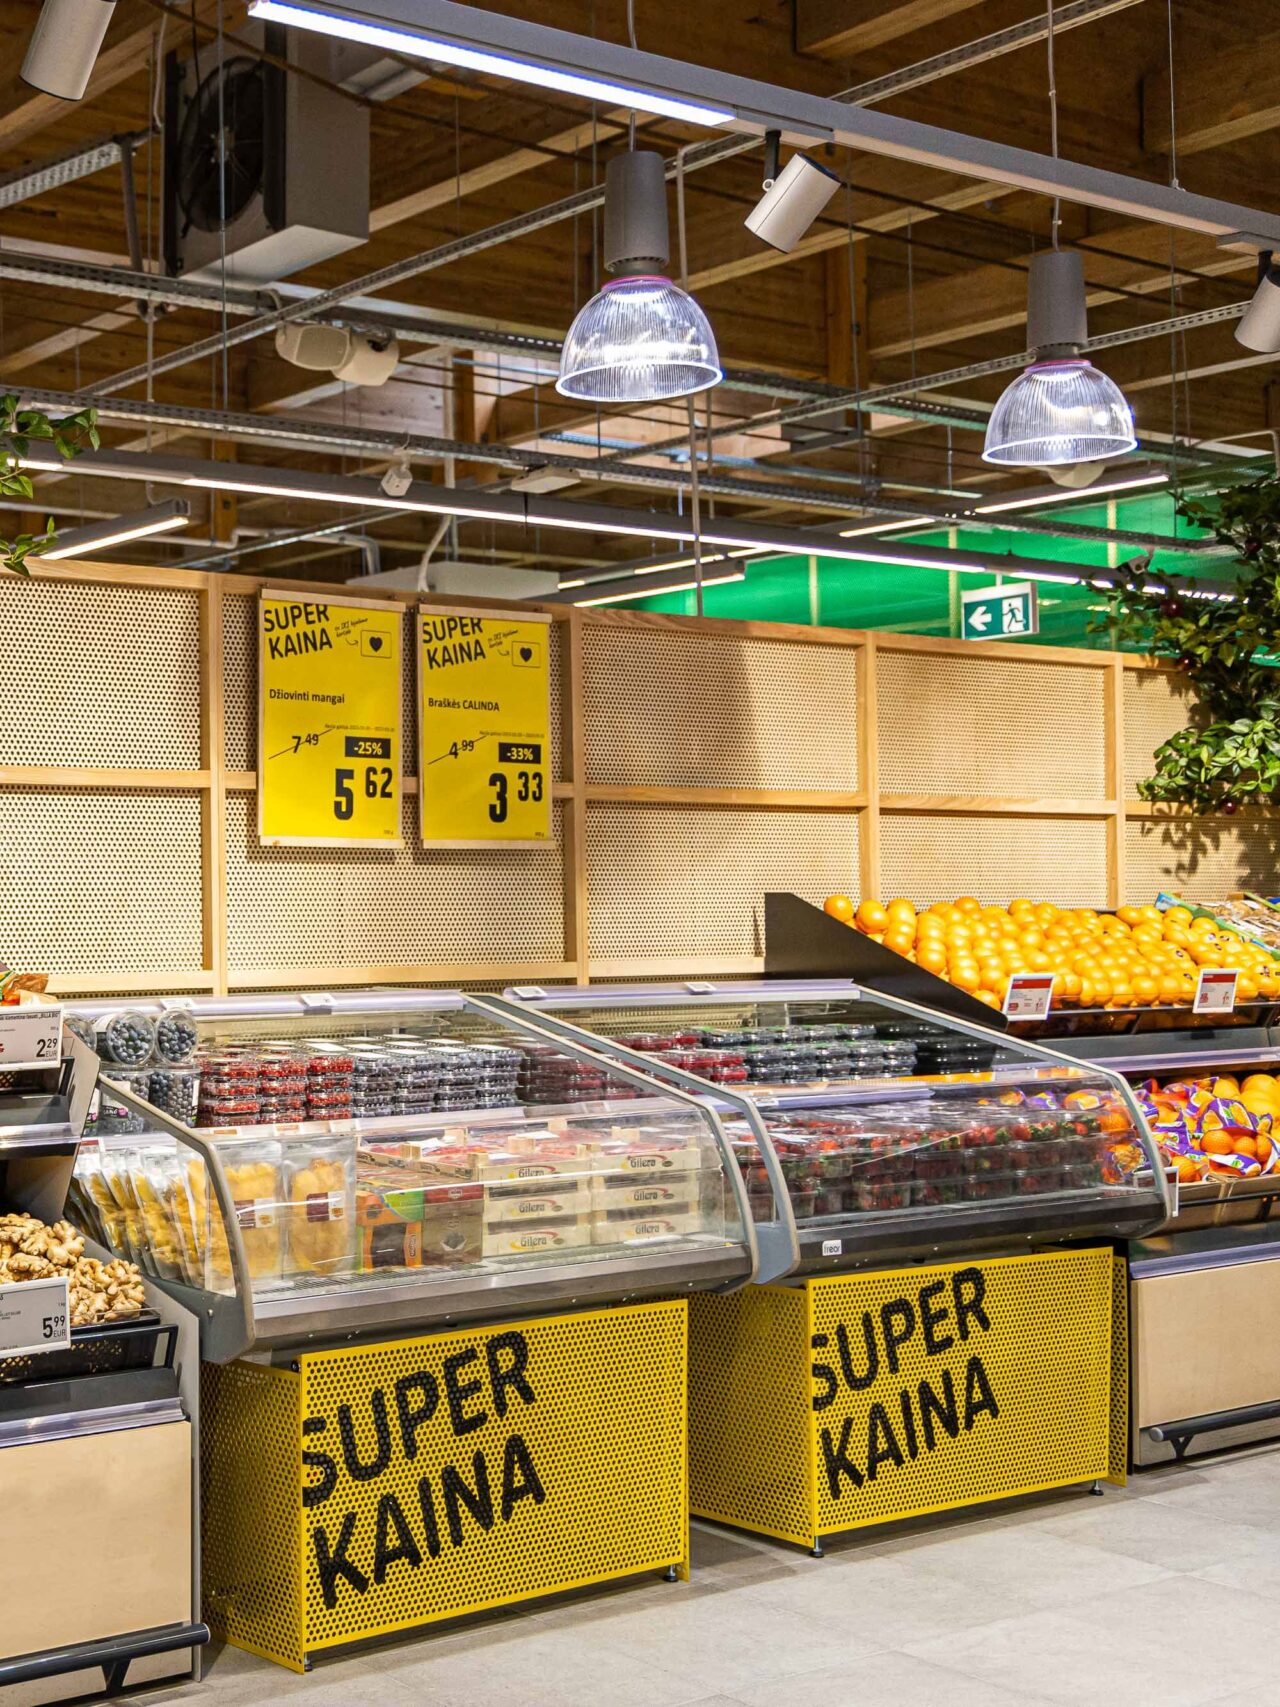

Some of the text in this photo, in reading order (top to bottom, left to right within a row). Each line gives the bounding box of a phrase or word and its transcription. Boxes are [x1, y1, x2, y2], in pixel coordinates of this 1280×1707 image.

[264, 602, 330, 632] SUPER
[422, 616, 483, 643] SUPER
[268, 627, 333, 660] KAINA
[426, 638, 486, 670] KAINA
[269, 688, 345, 706] Džiovinti mangai
[428, 697, 500, 712] Braškės CALINDA
[353, 741, 383, 756] -25%
[506, 747, 534, 760] -33%
[333, 765, 393, 821] 5 62
[488, 770, 543, 824] 3 33
[630, 1157, 656, 1168] Gilera
[633, 1190, 658, 1201] Gilera
[519, 1202, 545, 1213] Gilera
[635, 1223, 660, 1235] Gilera
[520, 1235, 547, 1248] Gilera
[53, 1329, 66, 1338] EUR
[811, 1266, 992, 1412] SUPER
[301, 1330, 537, 1508] SUPER
[821, 1355, 1000, 1501] KAINA
[312, 1433, 547, 1610] KAINA
